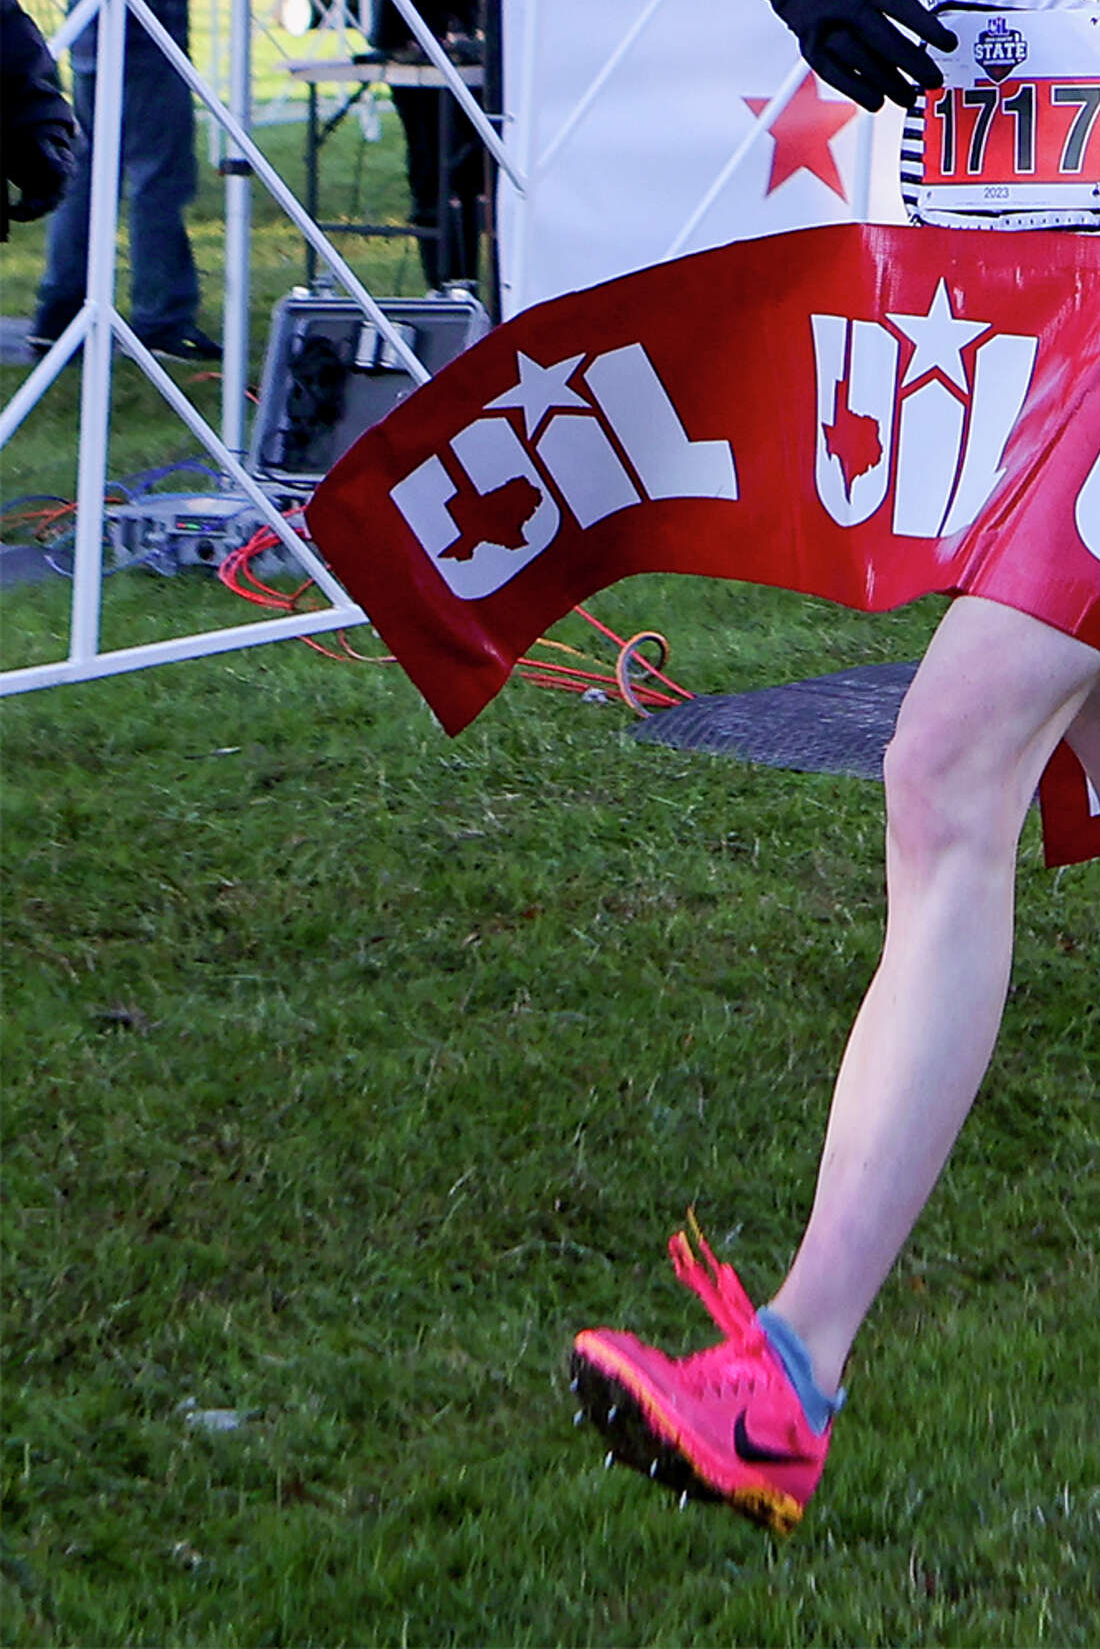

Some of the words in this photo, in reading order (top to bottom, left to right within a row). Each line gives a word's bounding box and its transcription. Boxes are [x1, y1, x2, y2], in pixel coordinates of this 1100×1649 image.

[975, 43, 1026, 60] STATE
[983, 187, 1010, 199] 2023
[389, 342, 740, 600] UIL
